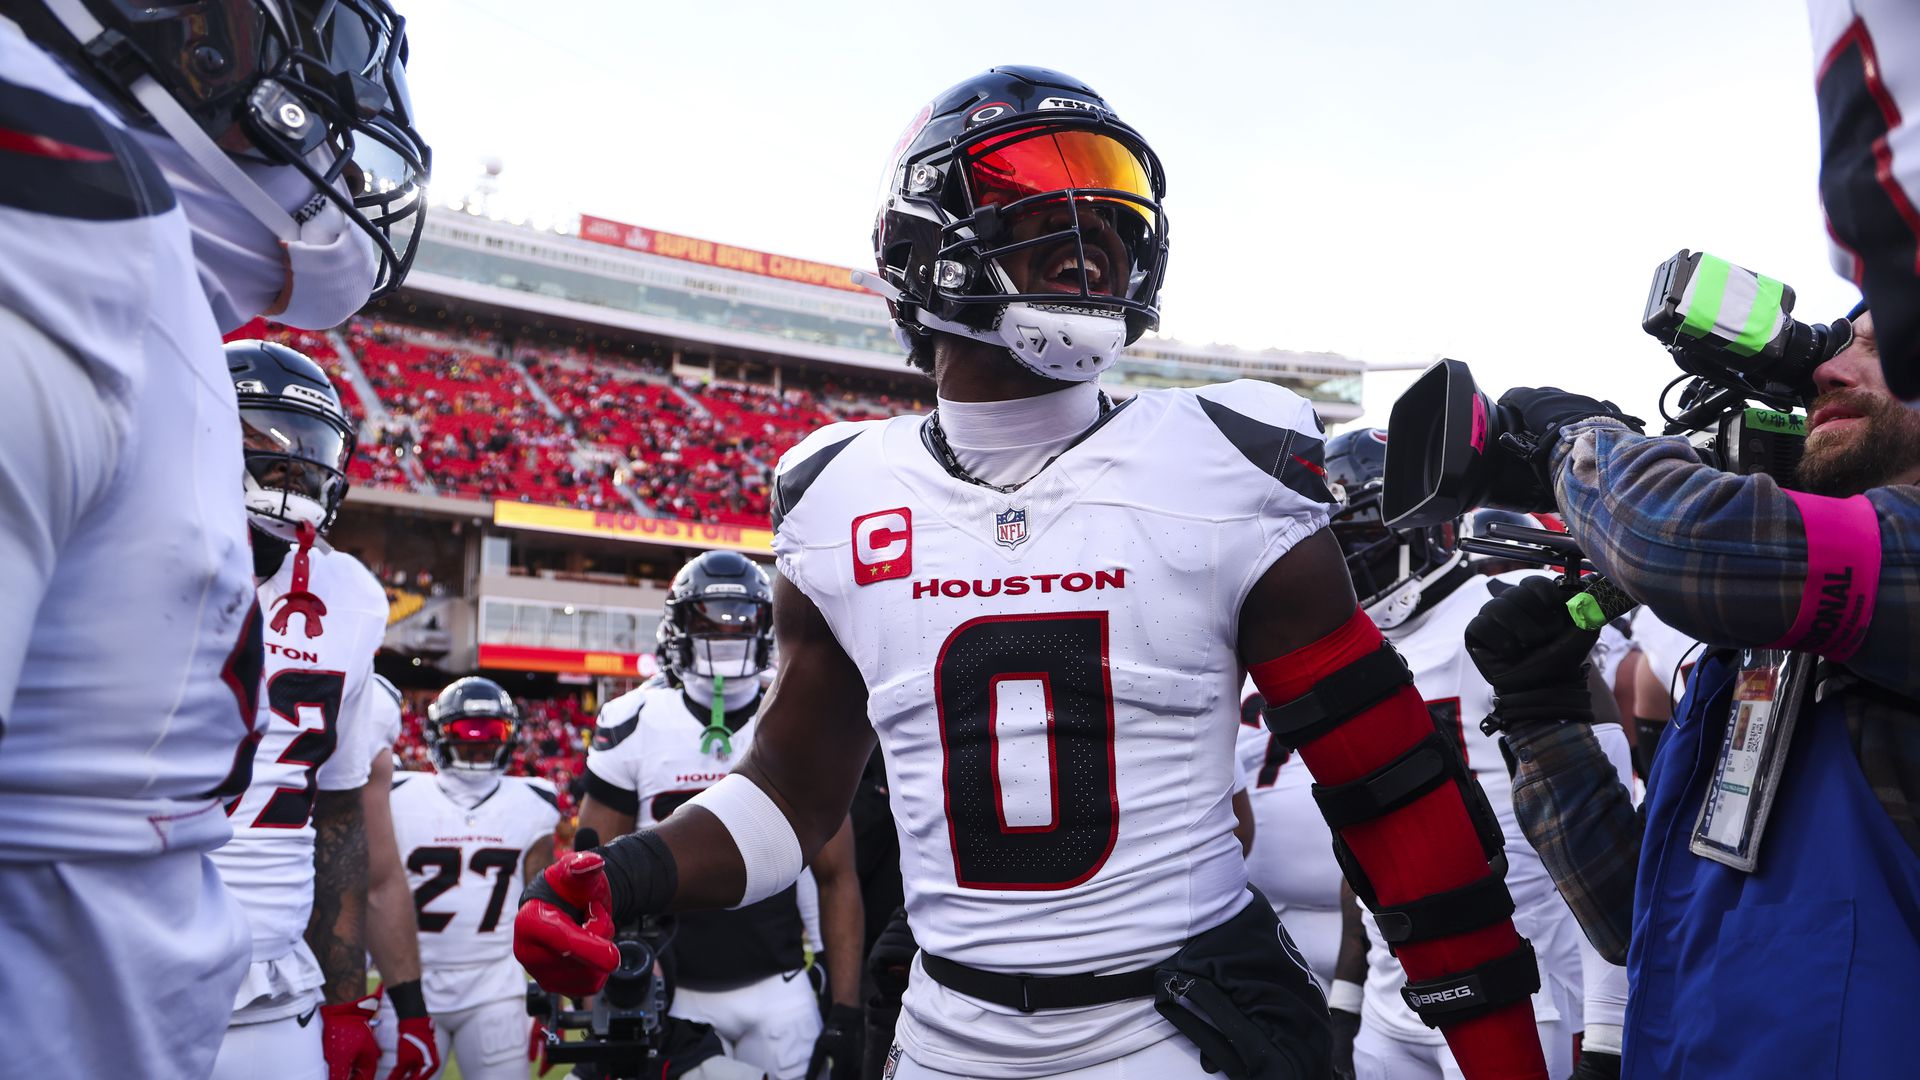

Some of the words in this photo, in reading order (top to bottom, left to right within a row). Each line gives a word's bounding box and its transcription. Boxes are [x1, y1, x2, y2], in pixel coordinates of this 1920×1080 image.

[654, 232, 712, 265] SUPER
[715, 244, 766, 276] BOWL
[592, 511, 742, 543] HOUSTON
[856, 513, 907, 566] C
[999, 523, 1027, 541] NFL
[912, 568, 1126, 600] HOUSTON
[1721, 708, 1738, 747] NFL
[933, 609, 1120, 892] 0
[406, 845, 523, 935] 27
